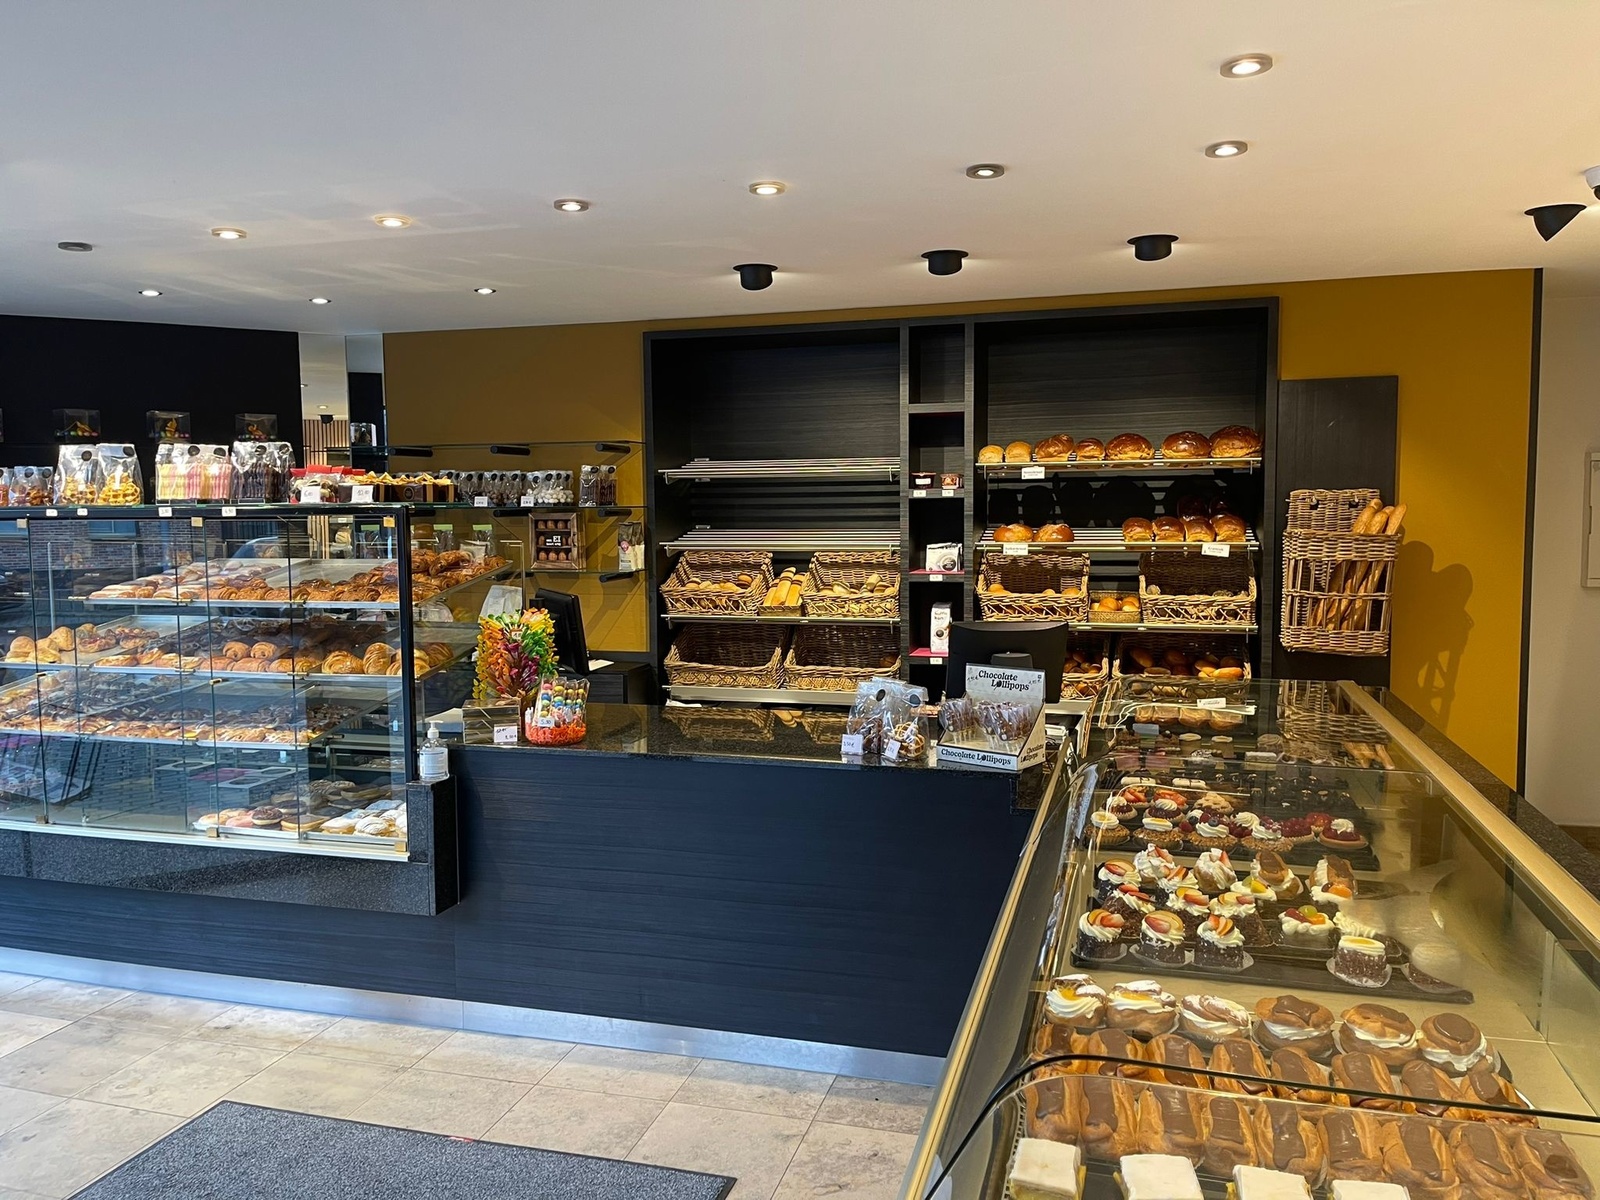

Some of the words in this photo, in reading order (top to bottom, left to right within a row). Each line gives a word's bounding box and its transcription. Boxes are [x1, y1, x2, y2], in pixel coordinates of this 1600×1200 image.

[979, 669, 1018, 681] Chocolate
[990, 680, 1030, 692] Lollipops
[941, 748, 975, 760] Chocolate
[976, 753, 1011, 765] Lollipops
